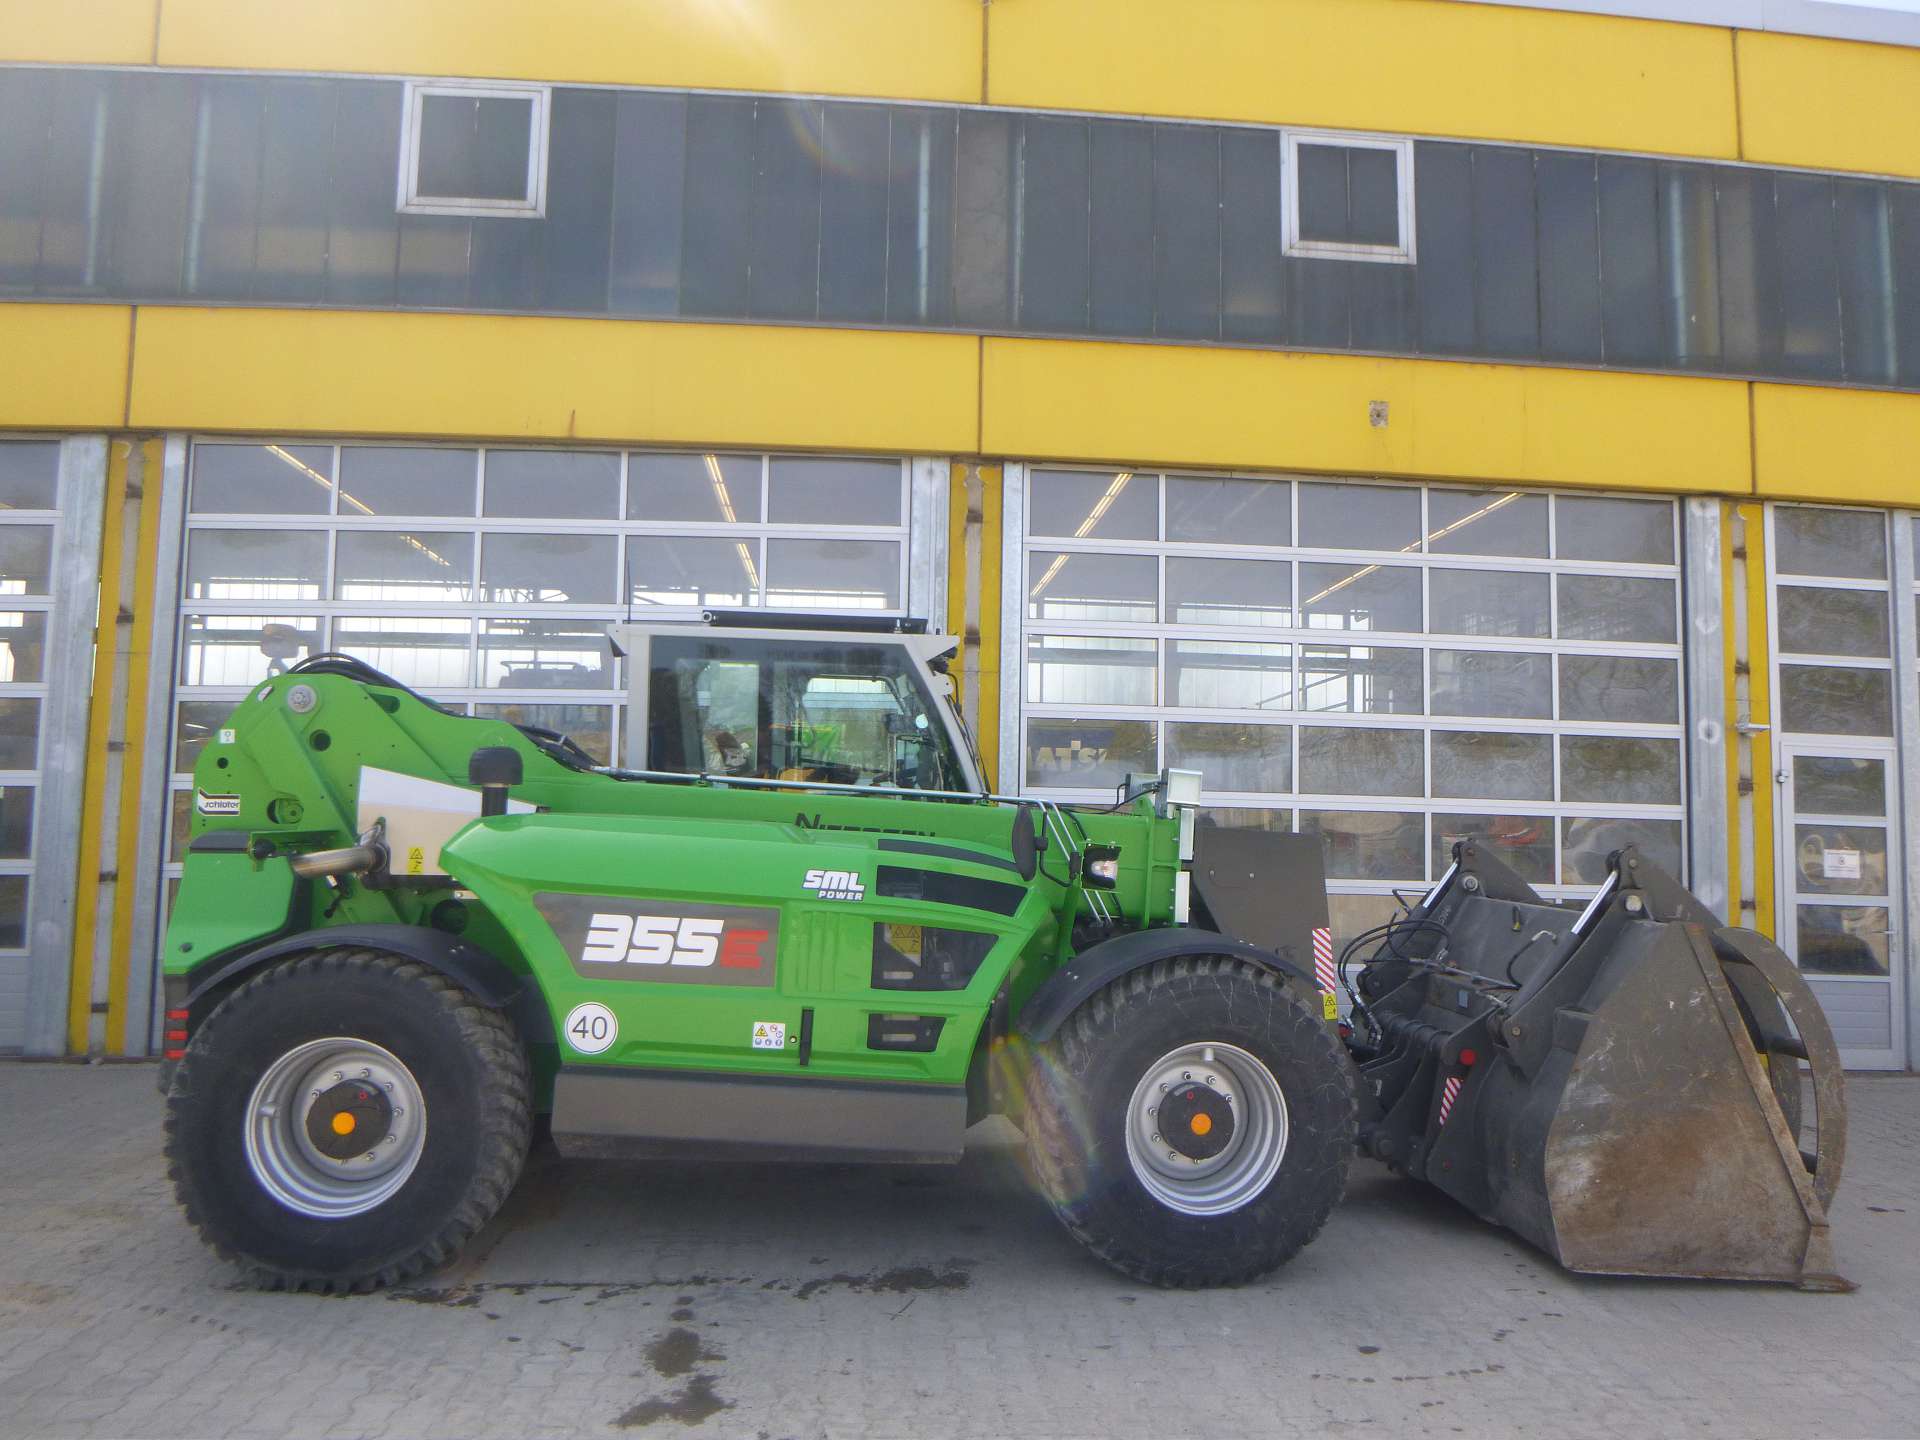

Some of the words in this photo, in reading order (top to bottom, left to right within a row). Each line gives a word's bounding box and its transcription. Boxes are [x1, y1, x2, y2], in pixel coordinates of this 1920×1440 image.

[803, 870, 865, 891] SML
[818, 891, 863, 900] POWER
[572, 1016, 608, 1040] 40
